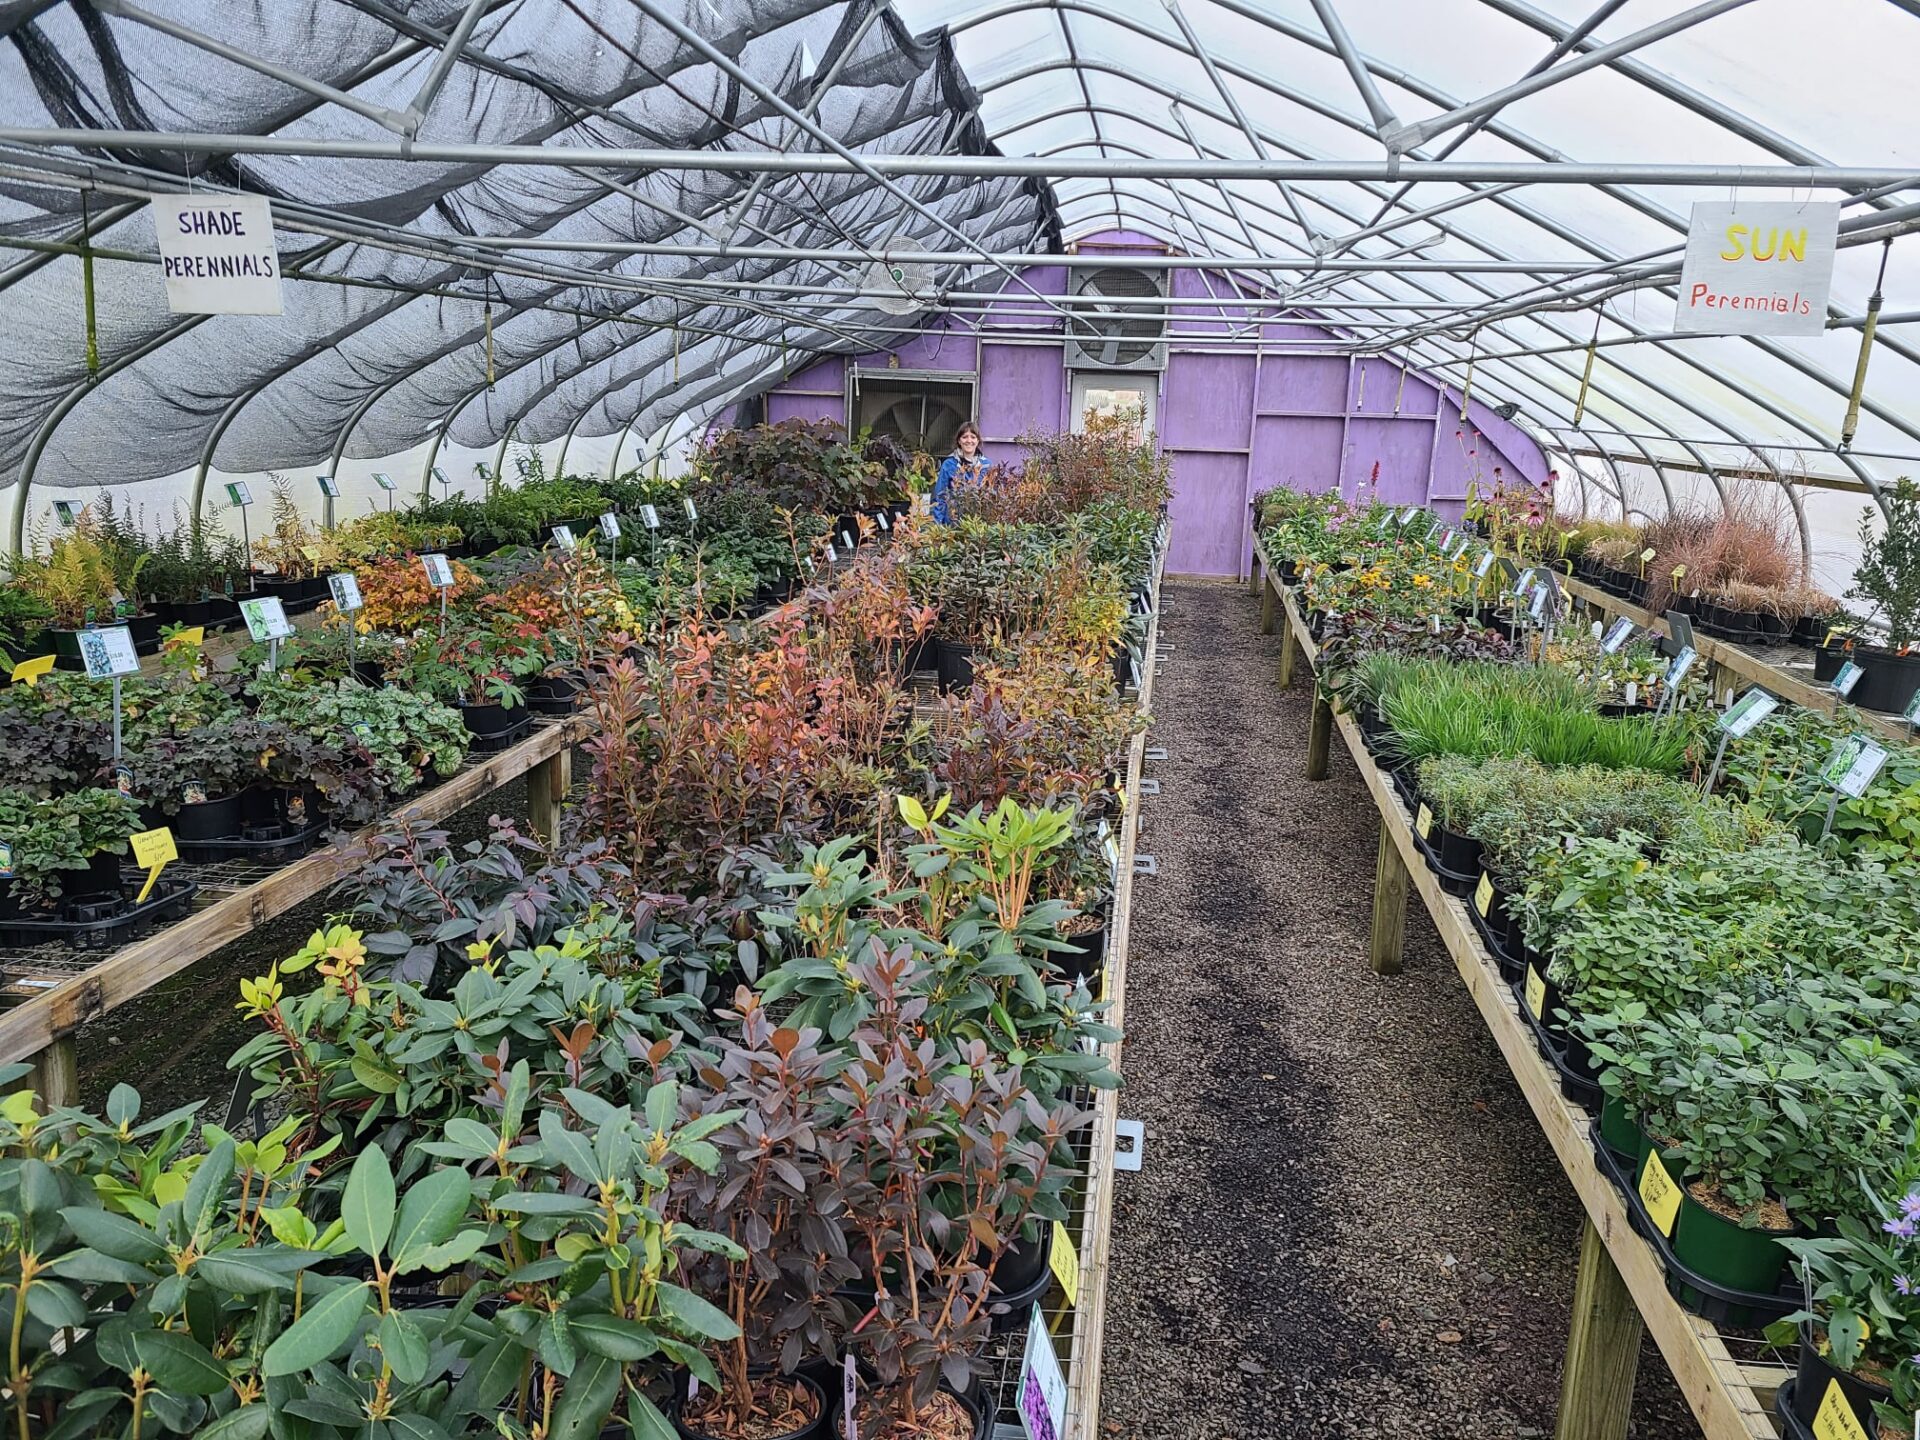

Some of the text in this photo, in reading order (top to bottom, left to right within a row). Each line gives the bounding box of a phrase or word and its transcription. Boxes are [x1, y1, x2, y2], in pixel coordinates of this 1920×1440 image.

[178, 210, 246, 236] SHADE
[1719, 223, 1809, 262] SUN
[164, 253, 273, 278] PERENNIALS
[1690, 283, 1811, 315] Perennials
